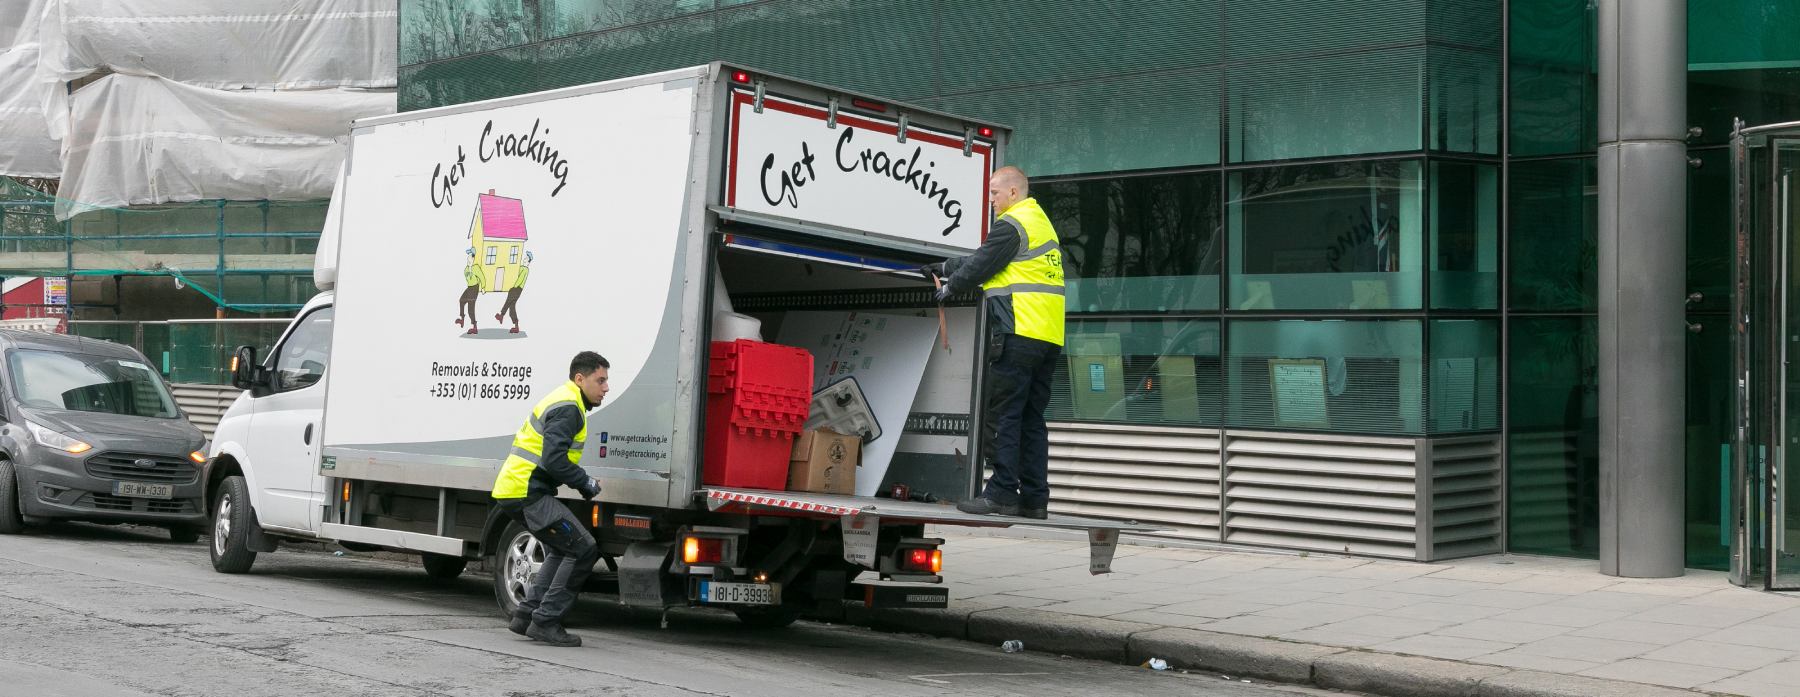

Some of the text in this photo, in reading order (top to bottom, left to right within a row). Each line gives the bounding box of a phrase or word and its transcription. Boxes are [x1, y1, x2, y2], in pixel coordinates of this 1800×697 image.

[431, 118, 569, 208] Get Cracking
[760, 126, 963, 237] Get Cracking
[431, 361, 532, 381] Removals & Storage
[430, 382, 531, 400] +353 (0)1 866 5999
[610, 434, 668, 445] www.getcracking.ie
[609, 447, 667, 460] info@getcracking.ie
